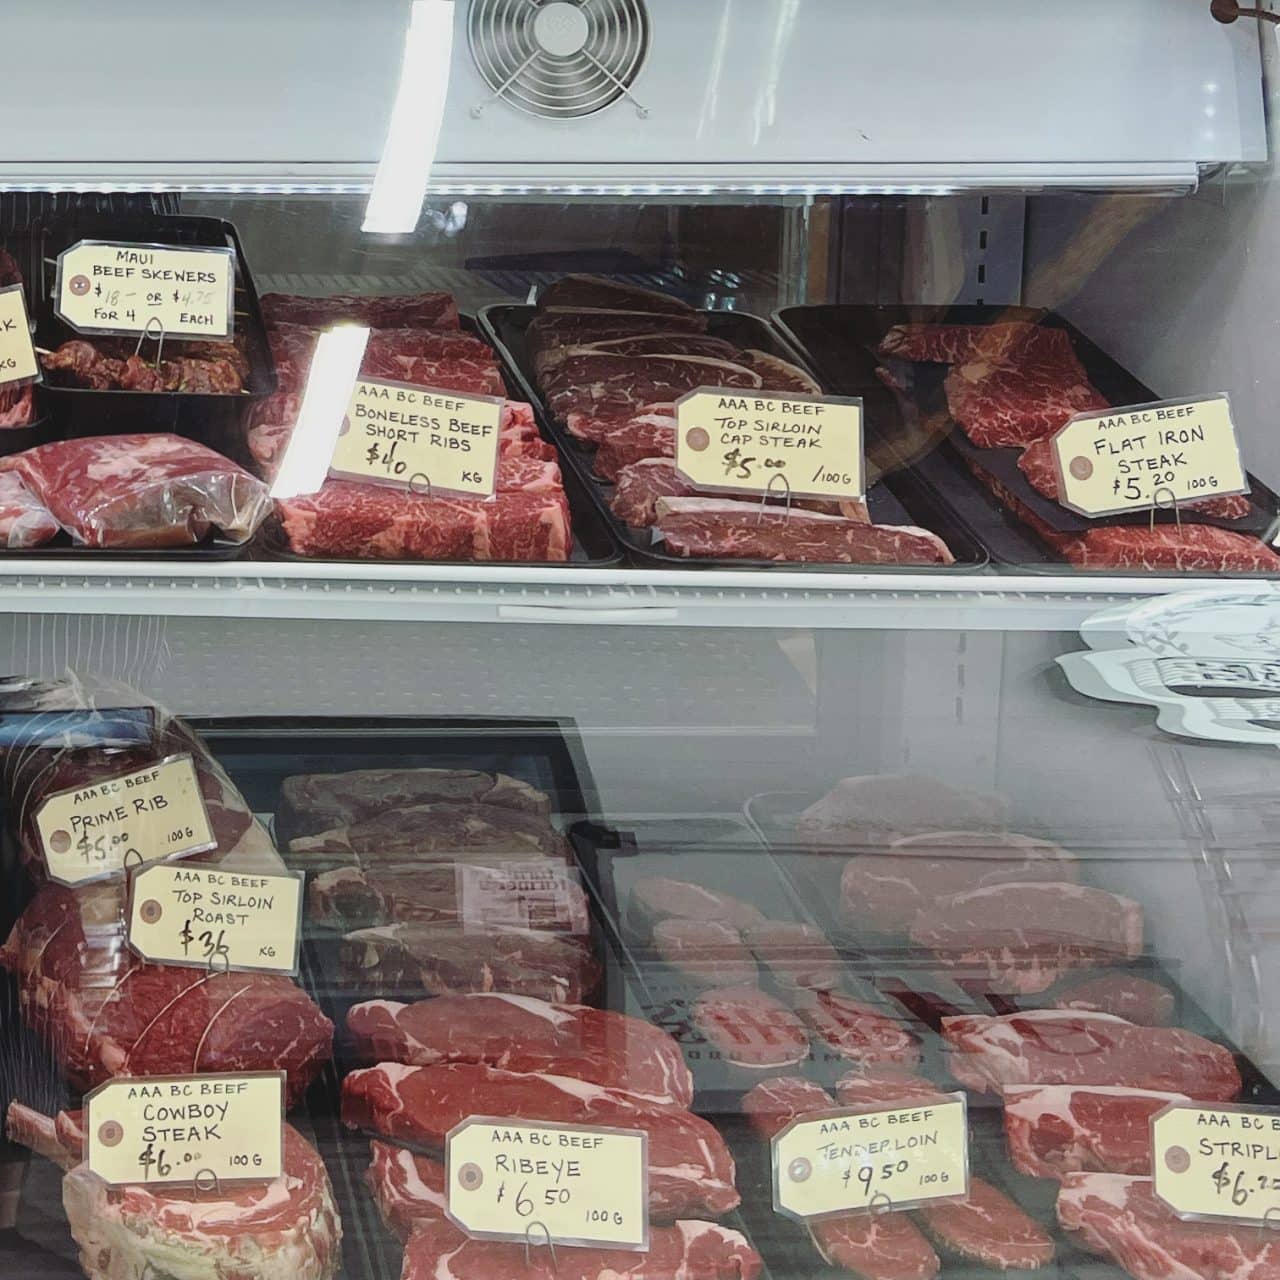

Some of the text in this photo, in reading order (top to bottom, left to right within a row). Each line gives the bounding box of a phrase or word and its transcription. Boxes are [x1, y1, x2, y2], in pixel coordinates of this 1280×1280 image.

[117, 251, 154, 264] MAUI
[93, 265, 216, 283] BEEF SKEWERS
[147, 292, 162, 303] OR
[94, 308, 213, 325] FOR 4 EACH
[359, 385, 465, 411] AAA BC BEEF
[718, 398, 825, 416] AAA BC BEEF
[356, 404, 493, 437] BONELESS BEEF
[714, 417, 822, 435] TOP SIRLOIN
[1098, 407, 1195, 431] AAA BC BEEF
[366, 424, 471, 452] SHORT RIBS
[721, 433, 822, 449] CAP STEAK
[1094, 425, 1204, 455] FLAT IRON
[366, 441, 482, 483] $40 KG
[1119, 452, 1187, 473] STEAK
[74, 791, 97, 805] AAA
[125, 771, 160, 788] BEEF
[70, 795, 168, 832] PRIME RIB
[174, 872, 269, 888] AAA BC BEEF
[172, 889, 274, 909] TOP SIRLOIN
[192, 908, 249, 926] ROAST
[179, 920, 275, 957] $36 KG
[128, 1083, 248, 1099] AAA BC BEEF
[144, 1101, 229, 1121] COWBOY
[820, 1111, 934, 1134] AAA BC BEEF
[1198, 1114, 1230, 1128] AAA
[1241, 1117, 1264, 1129] BC
[142, 1124, 222, 1142] STEAK
[492, 1130, 604, 1148] AAA BC BEEF
[1200, 1138, 1280, 1160] STRIPL
[496, 1154, 581, 1184] RIBEYE
